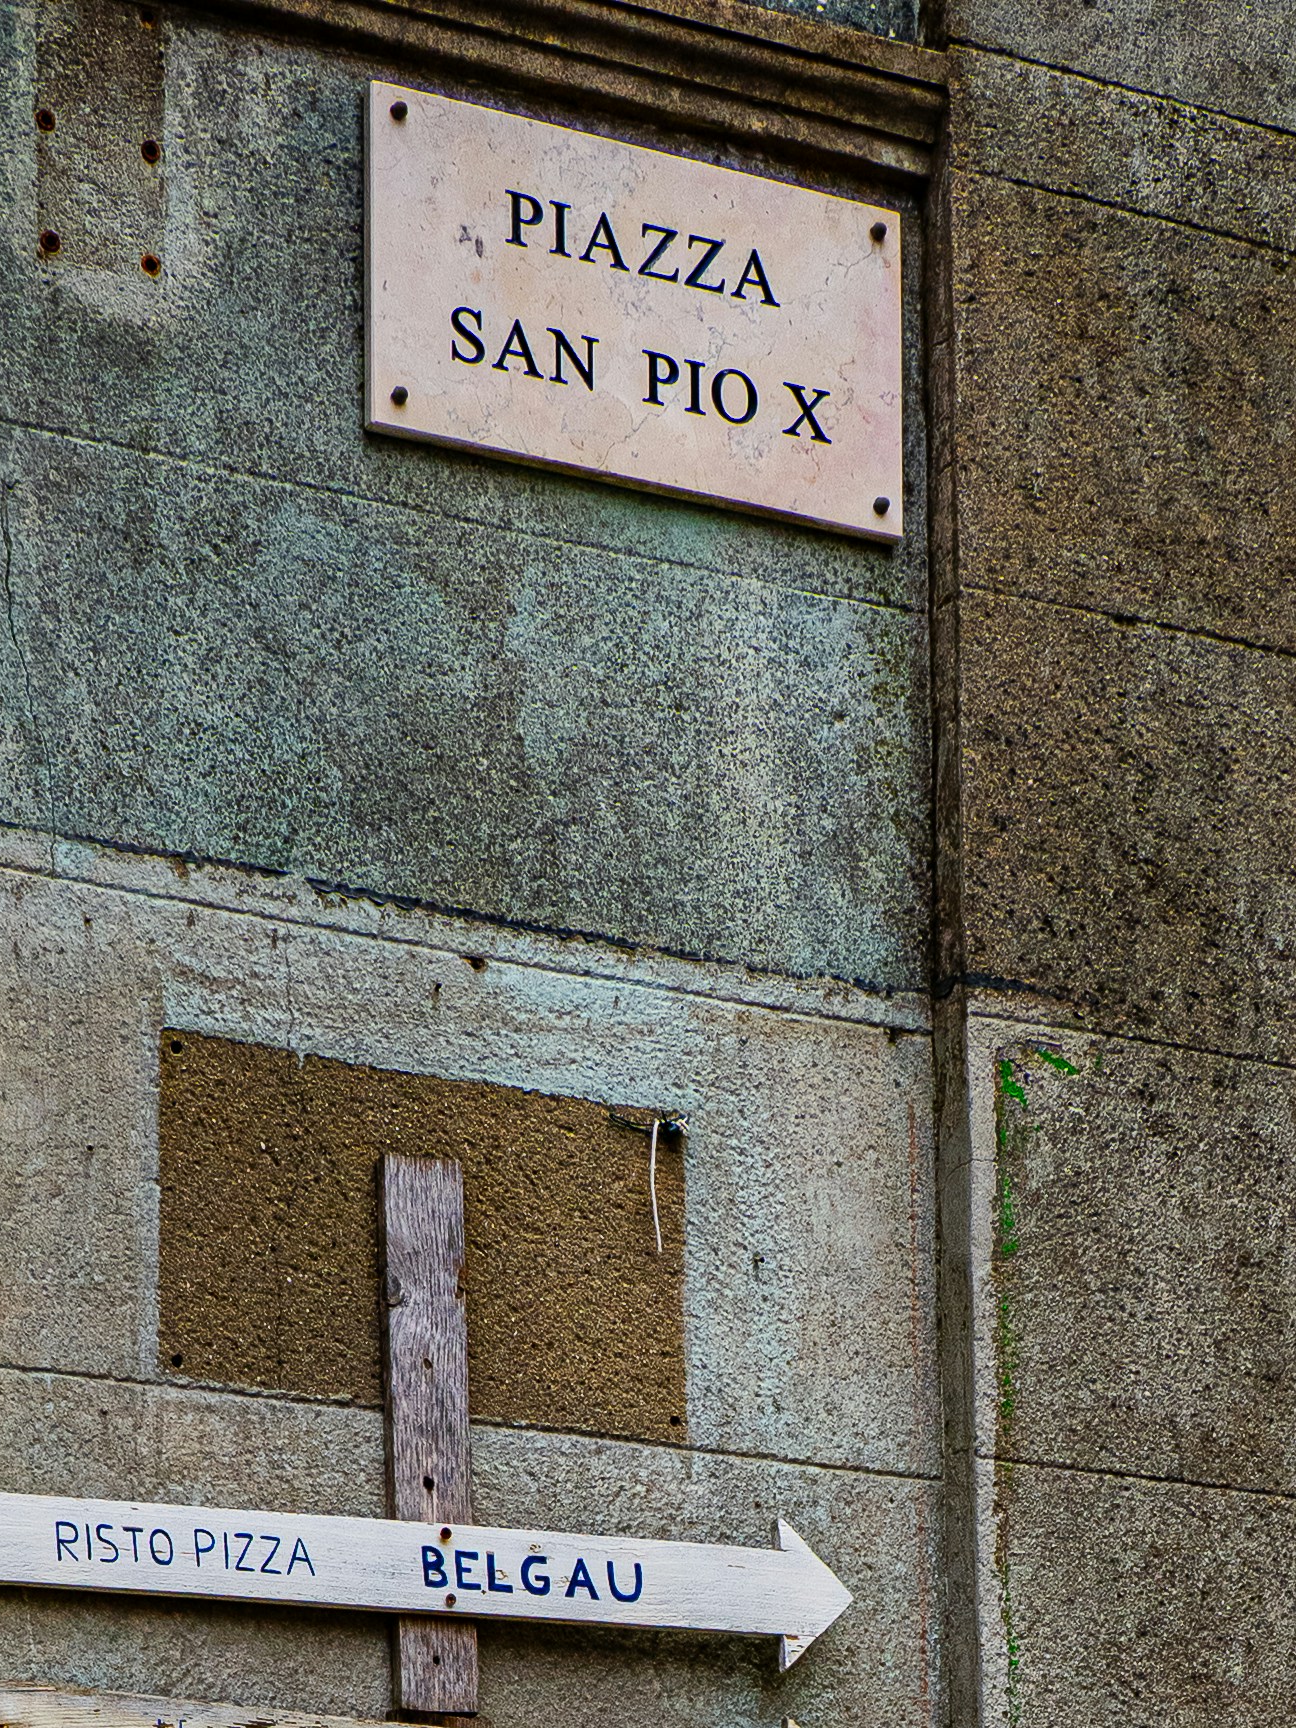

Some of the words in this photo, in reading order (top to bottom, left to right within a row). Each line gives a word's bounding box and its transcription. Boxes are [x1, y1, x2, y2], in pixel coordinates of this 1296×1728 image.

[505, 189, 780, 307] PIAZZA
[450, 307, 600, 391] SAN
[642, 349, 759, 425] PIO
[782, 382, 832, 444] X
[56, 1520, 173, 1566] RISTO
[194, 1528, 315, 1577] PIZZA
[422, 1545, 643, 1602] BELGAU
